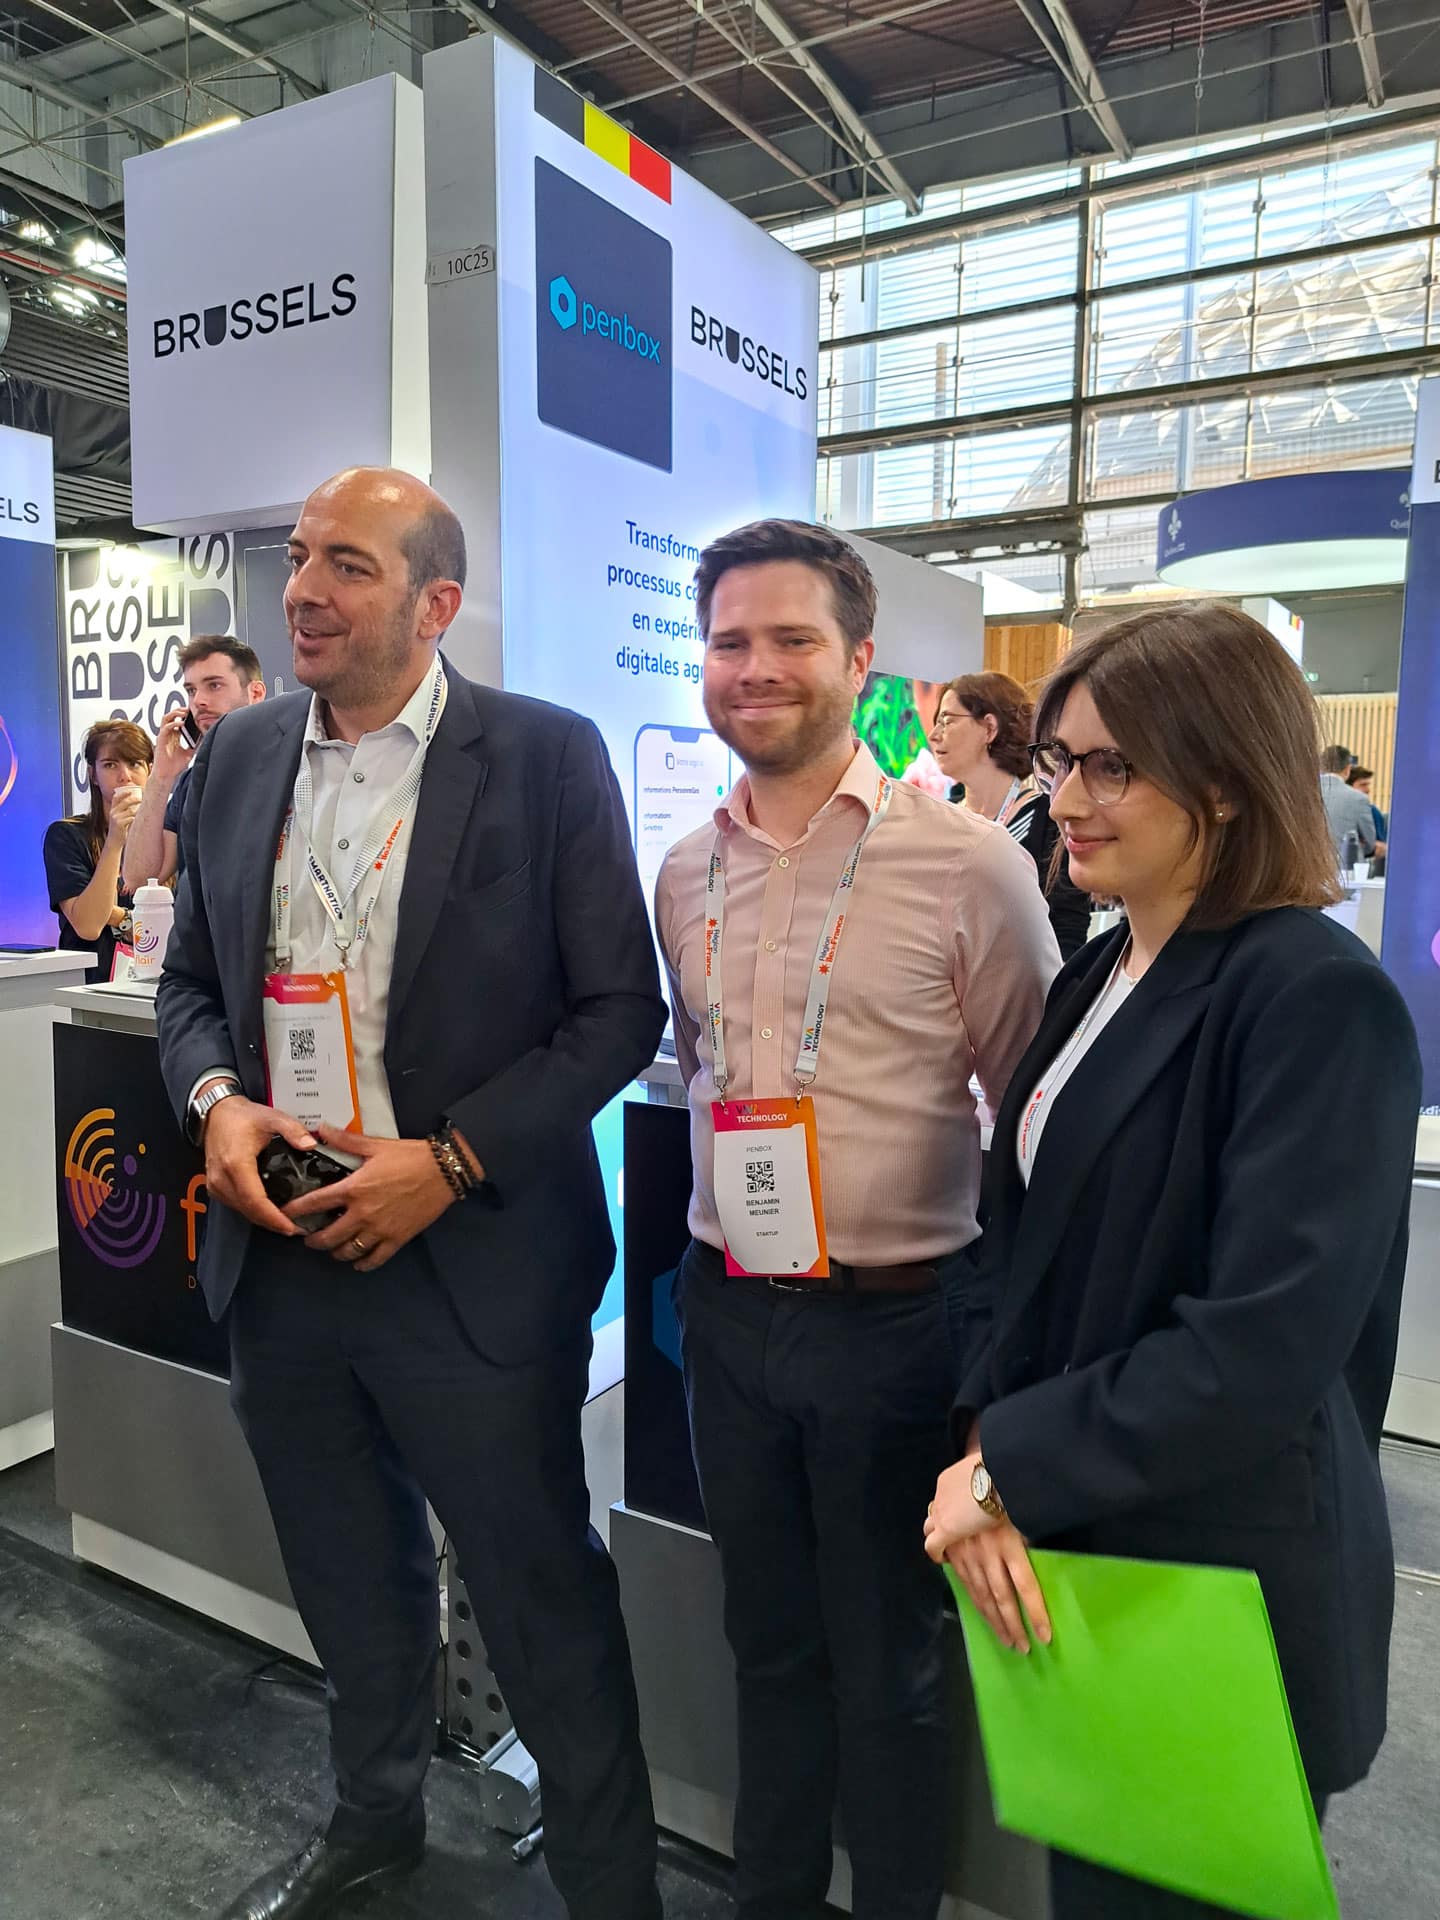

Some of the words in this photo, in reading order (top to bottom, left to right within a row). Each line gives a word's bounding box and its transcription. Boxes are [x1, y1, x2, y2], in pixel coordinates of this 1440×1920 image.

[448, 250, 489, 276] 10C25
[153, 273, 357, 358] BRUSSELS
[583, 301, 661, 364] penbox
[690, 305, 808, 400] BRUSSELS
[626, 520, 700, 563] Transform
[607, 563, 681, 598] processus
[632, 612, 650, 632] en
[616, 646, 680, 676] digitales
[803, 1027, 814, 1051] VIVA
[812, 1002, 825, 1053] TECHNOLOGY
[736, 1113, 788, 1124] TECHNOLOGY
[746, 1145, 773, 1153] PENBOX
[746, 1197, 780, 1207] BENJAMIN
[749, 1208, 780, 1217] MEUNIER
[756, 1230, 779, 1238] STARTUP
